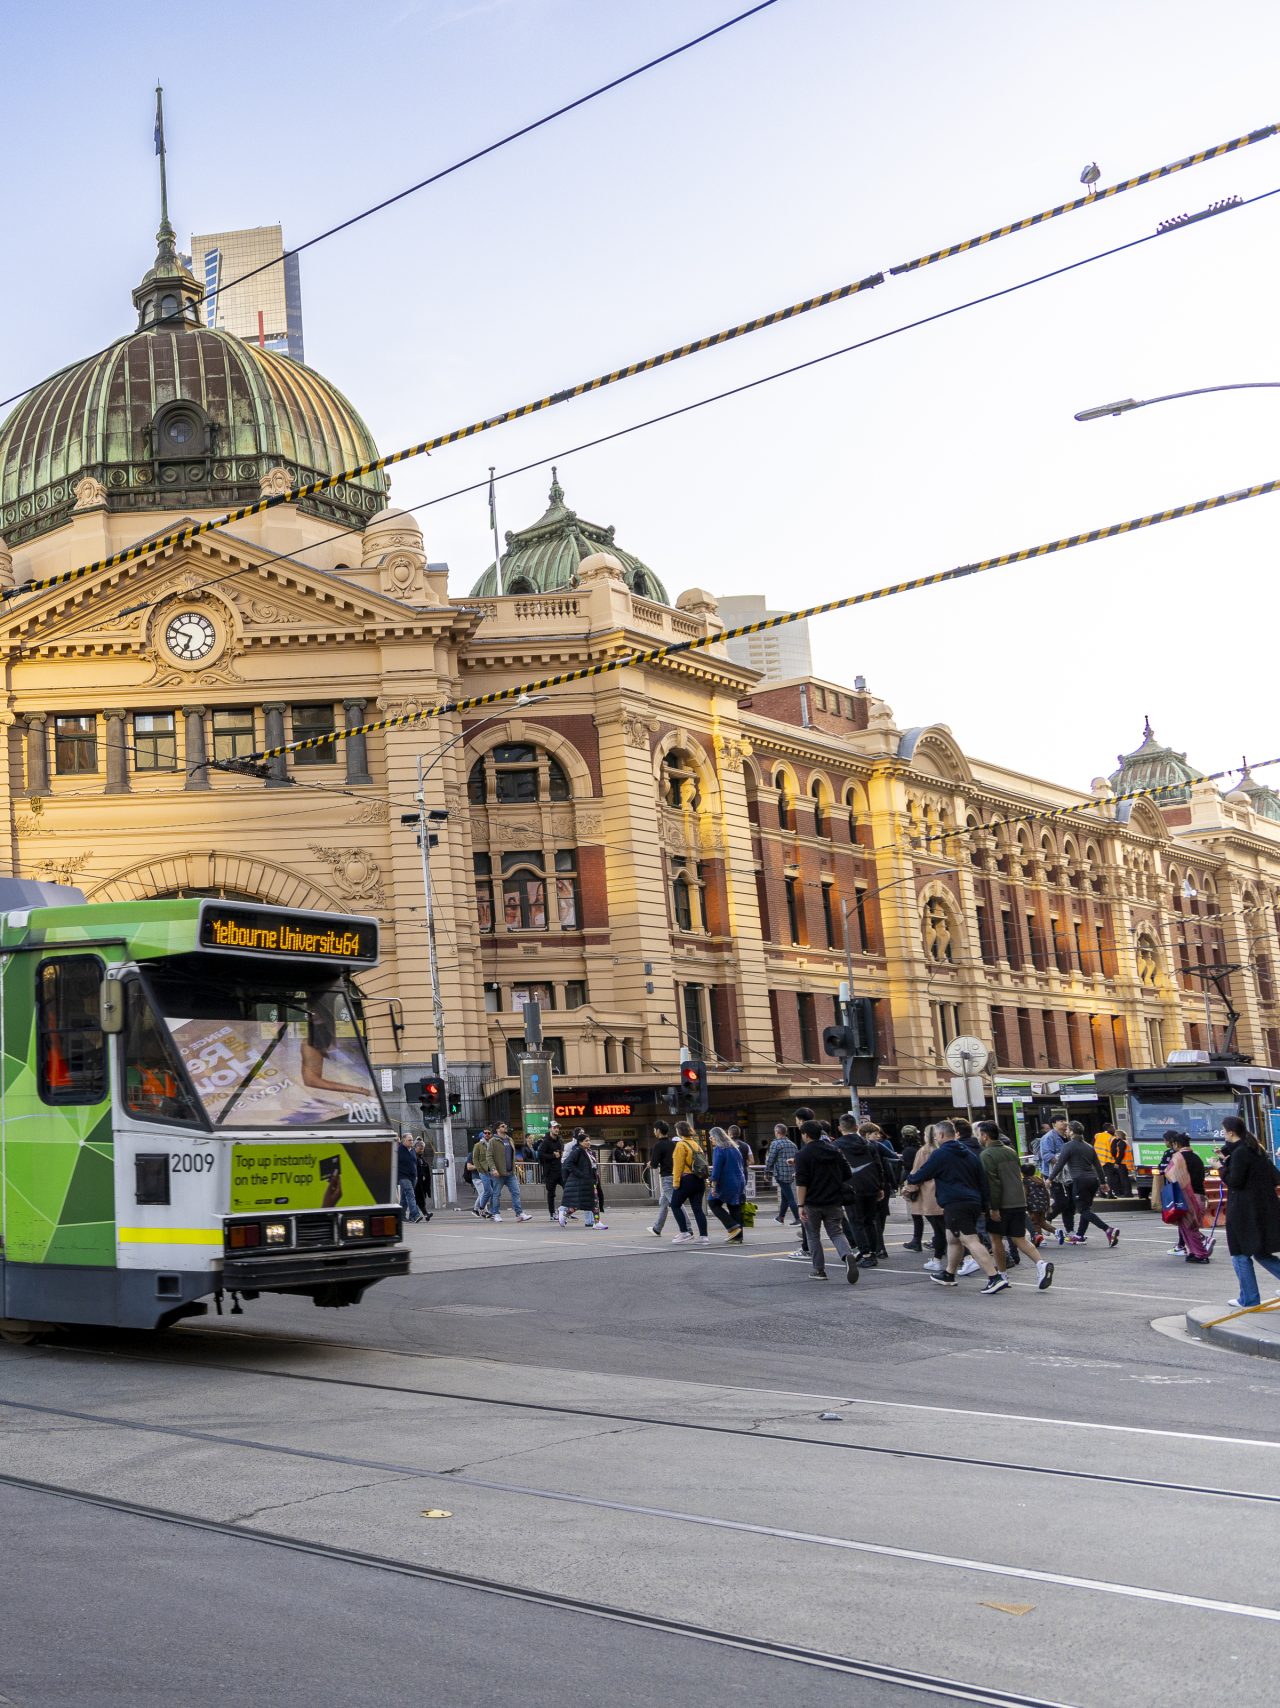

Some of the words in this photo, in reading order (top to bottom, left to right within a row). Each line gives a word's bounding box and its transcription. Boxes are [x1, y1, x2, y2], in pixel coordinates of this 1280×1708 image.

[30, 797, 41, 805] CUT
[343, 1102, 381, 1123] 2009
[556, 1106, 586, 1116] CITY
[594, 1104, 631, 1115] HATTERS
[171, 1153, 215, 1173] 2009
[235, 1154, 251, 1170] Top
[258, 1156, 271, 1170] up
[273, 1154, 317, 1169] instantly
[235, 1175, 249, 1186] on
[251, 1173, 269, 1185] the
[271, 1172, 293, 1185] PTV
[293, 1174, 314, 1187] app
